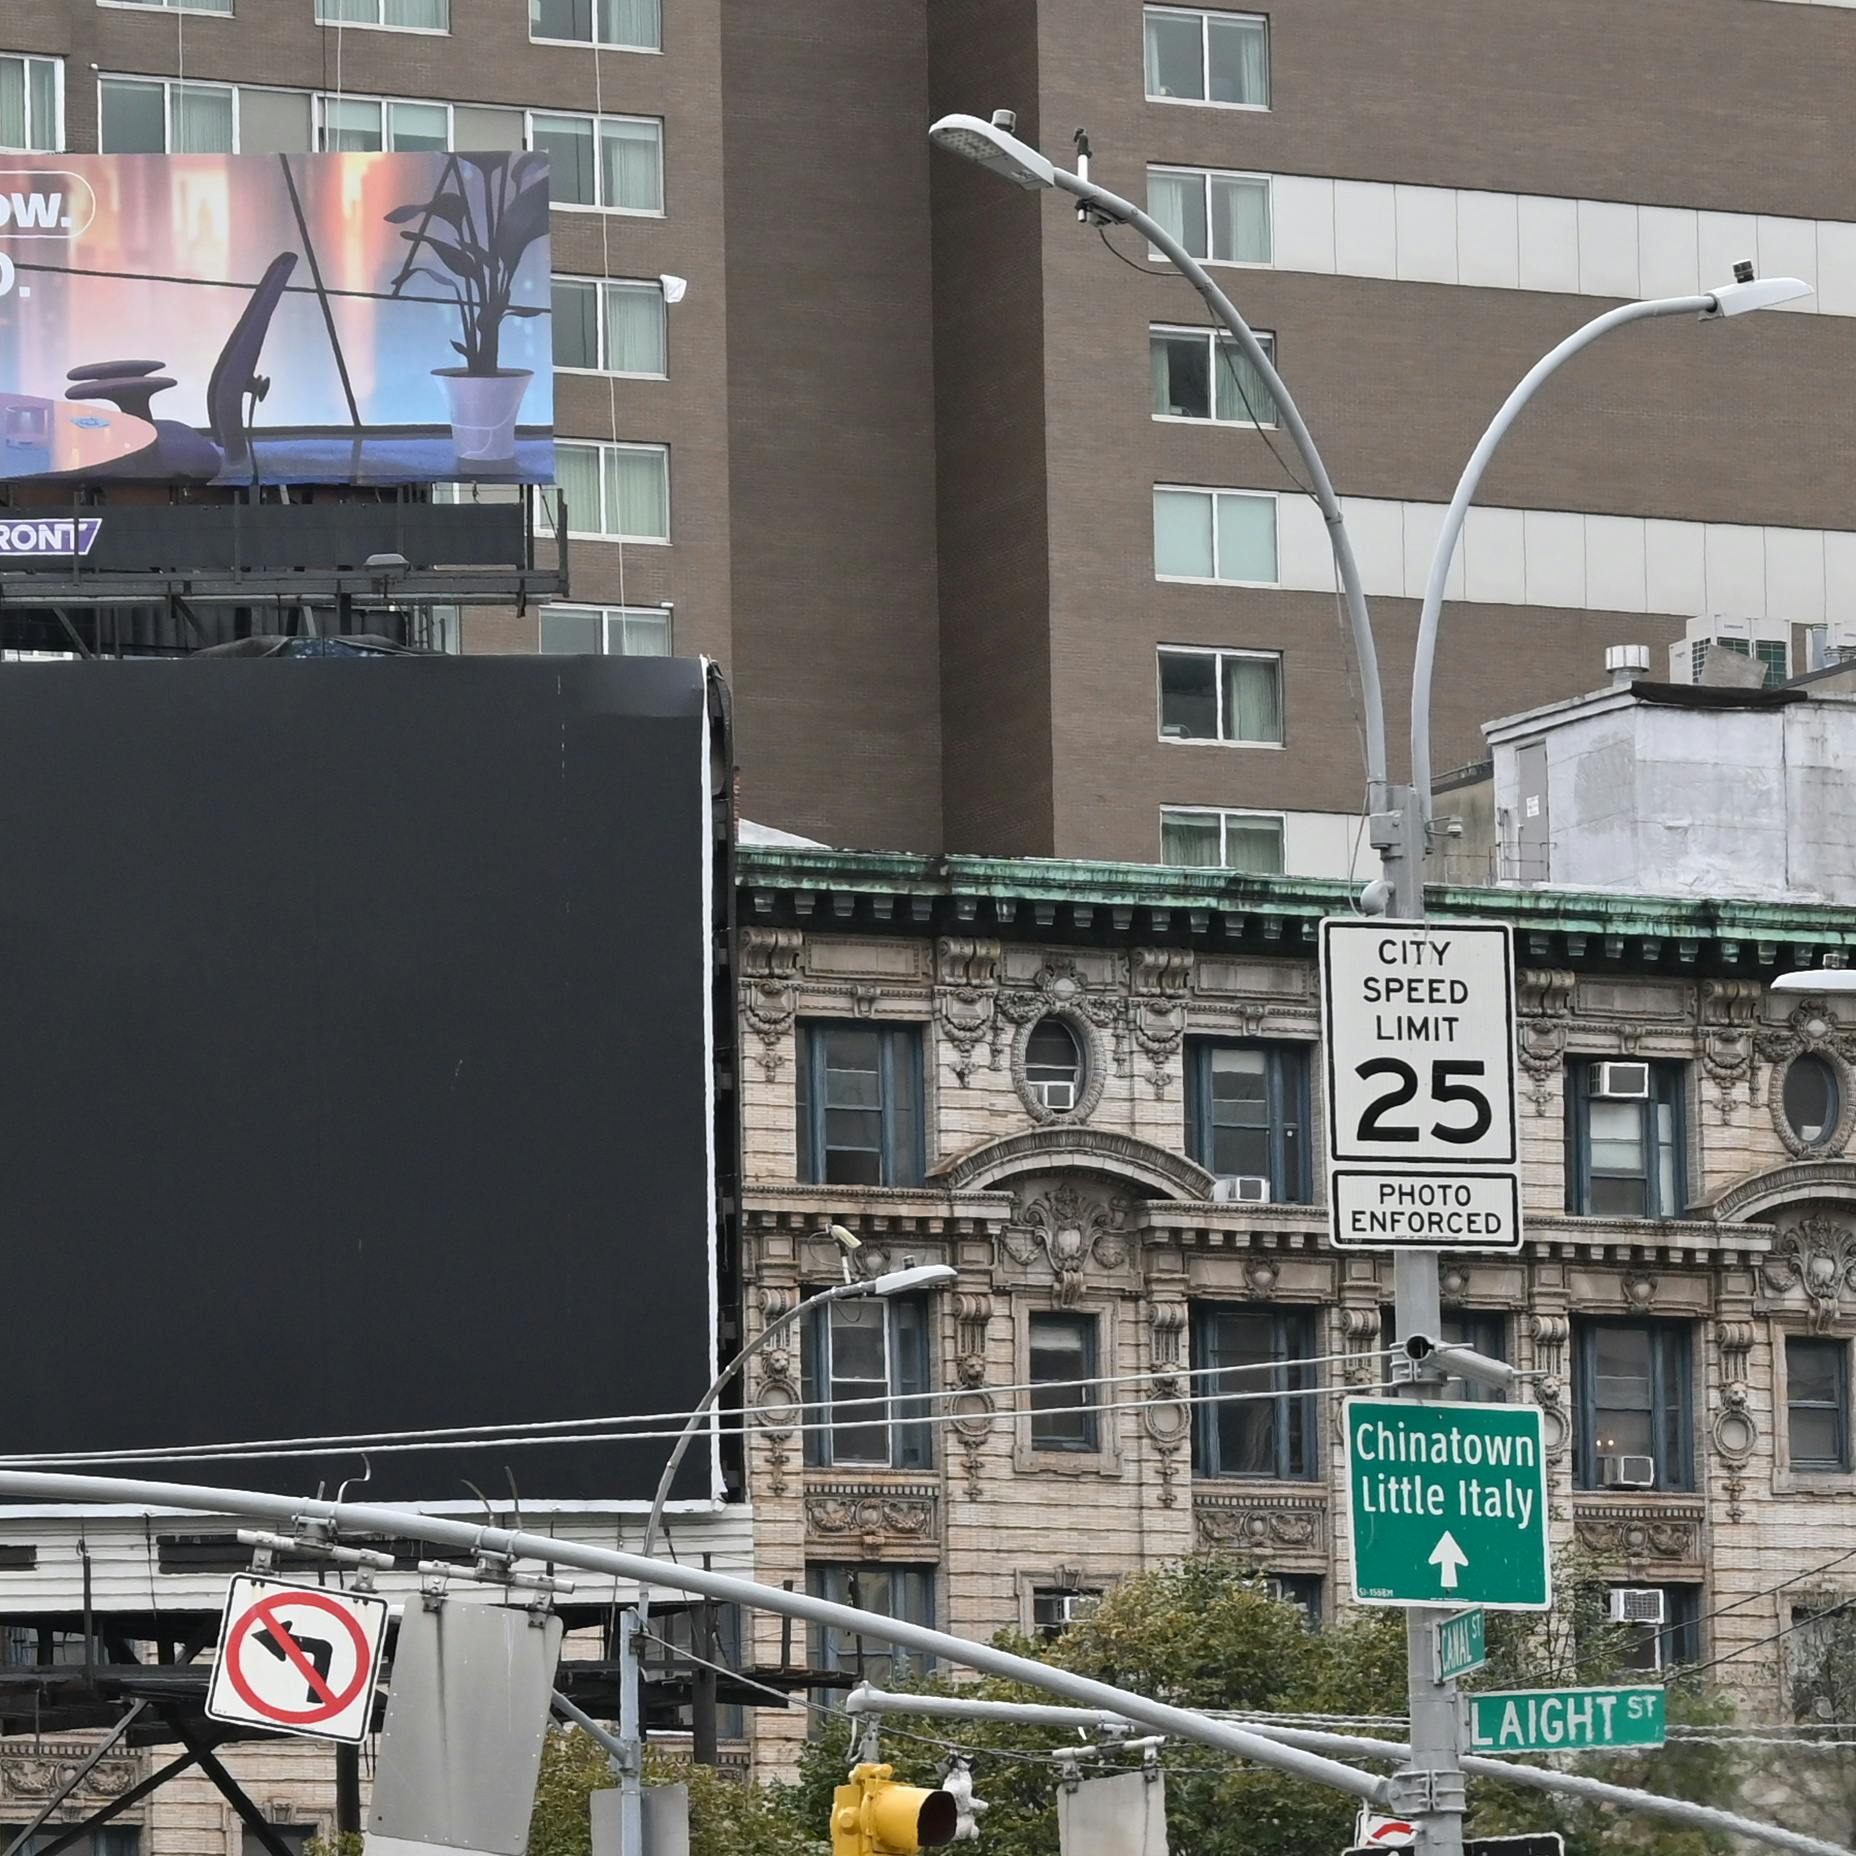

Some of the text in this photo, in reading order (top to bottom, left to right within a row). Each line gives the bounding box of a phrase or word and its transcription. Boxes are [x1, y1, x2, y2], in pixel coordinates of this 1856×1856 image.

[1378, 939, 1451, 966] CITY
[1363, 977, 1468, 1004] SPEED
[1376, 1015, 1459, 1042] LIMIT
[1355, 1057, 1492, 1144] 25
[1380, 1184, 1471, 1206] PHOTO
[1352, 1210, 1501, 1234] ENFORCED
[1357, 1422, 1534, 1468] Chinatown
[1362, 1474, 1533, 1529] Little Italy
[1444, 1619, 1472, 1672] CANAL
[1472, 1614, 1480, 1639] ST
[1471, 1695, 1656, 1746] LAIGHT ST
